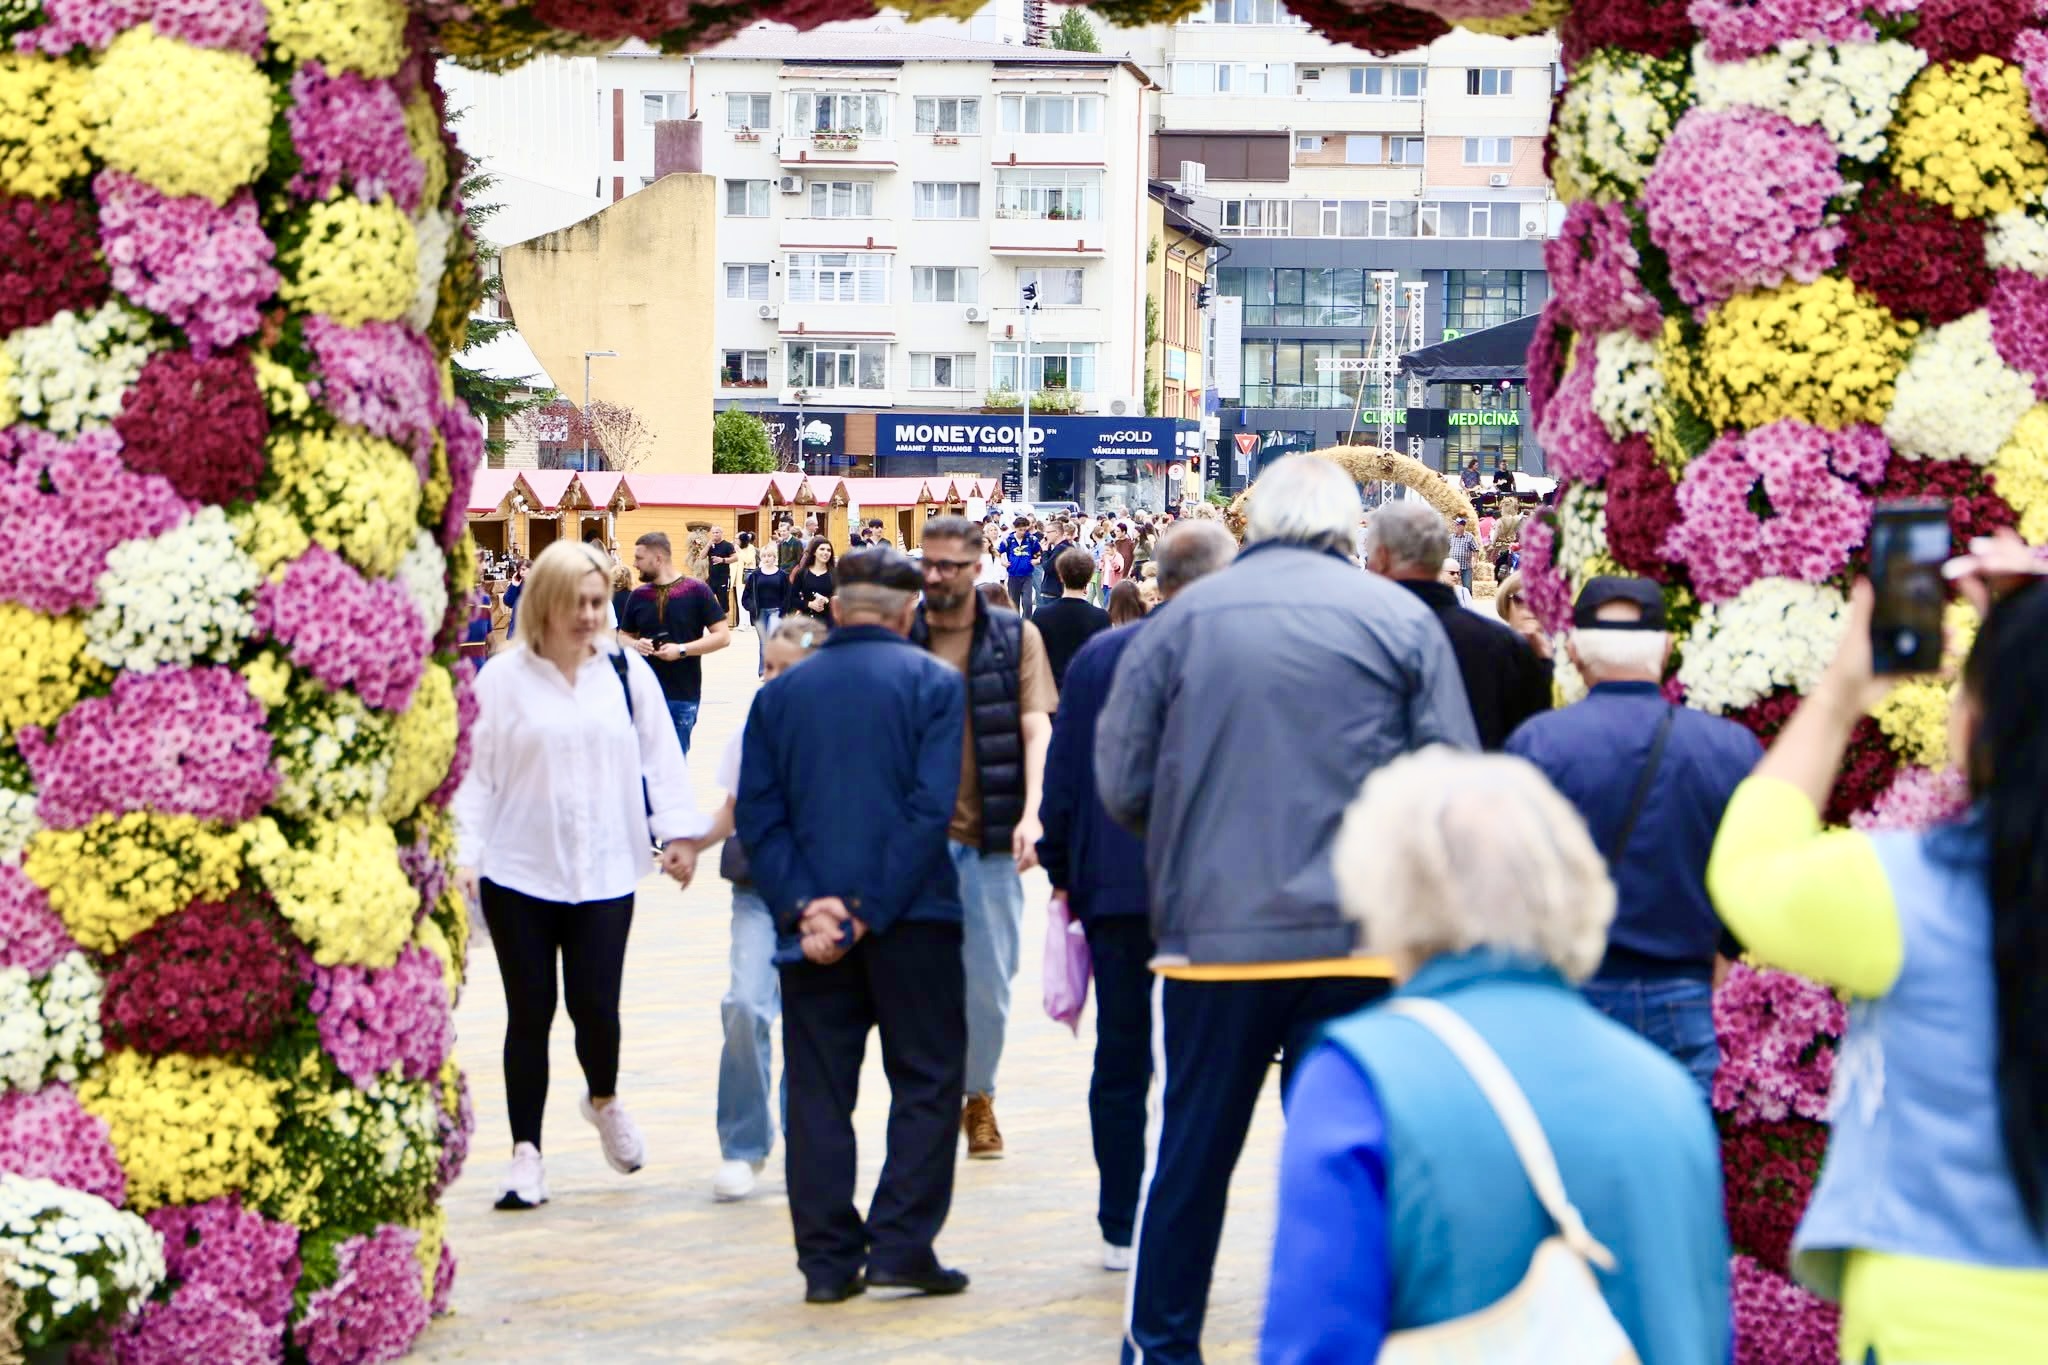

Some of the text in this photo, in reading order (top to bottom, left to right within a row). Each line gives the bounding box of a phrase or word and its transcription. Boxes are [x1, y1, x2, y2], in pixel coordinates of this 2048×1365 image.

[895, 425, 1045, 445] MONEYGOLD
[1099, 431, 1152, 445] myGOLD
[896, 444, 926, 452] AMANET
[932, 445, 972, 453] EXCHANGE
[978, 446, 1015, 454] TRANSFER
[1092, 445, 1158, 456] VÂNZARE BIJUTERII
